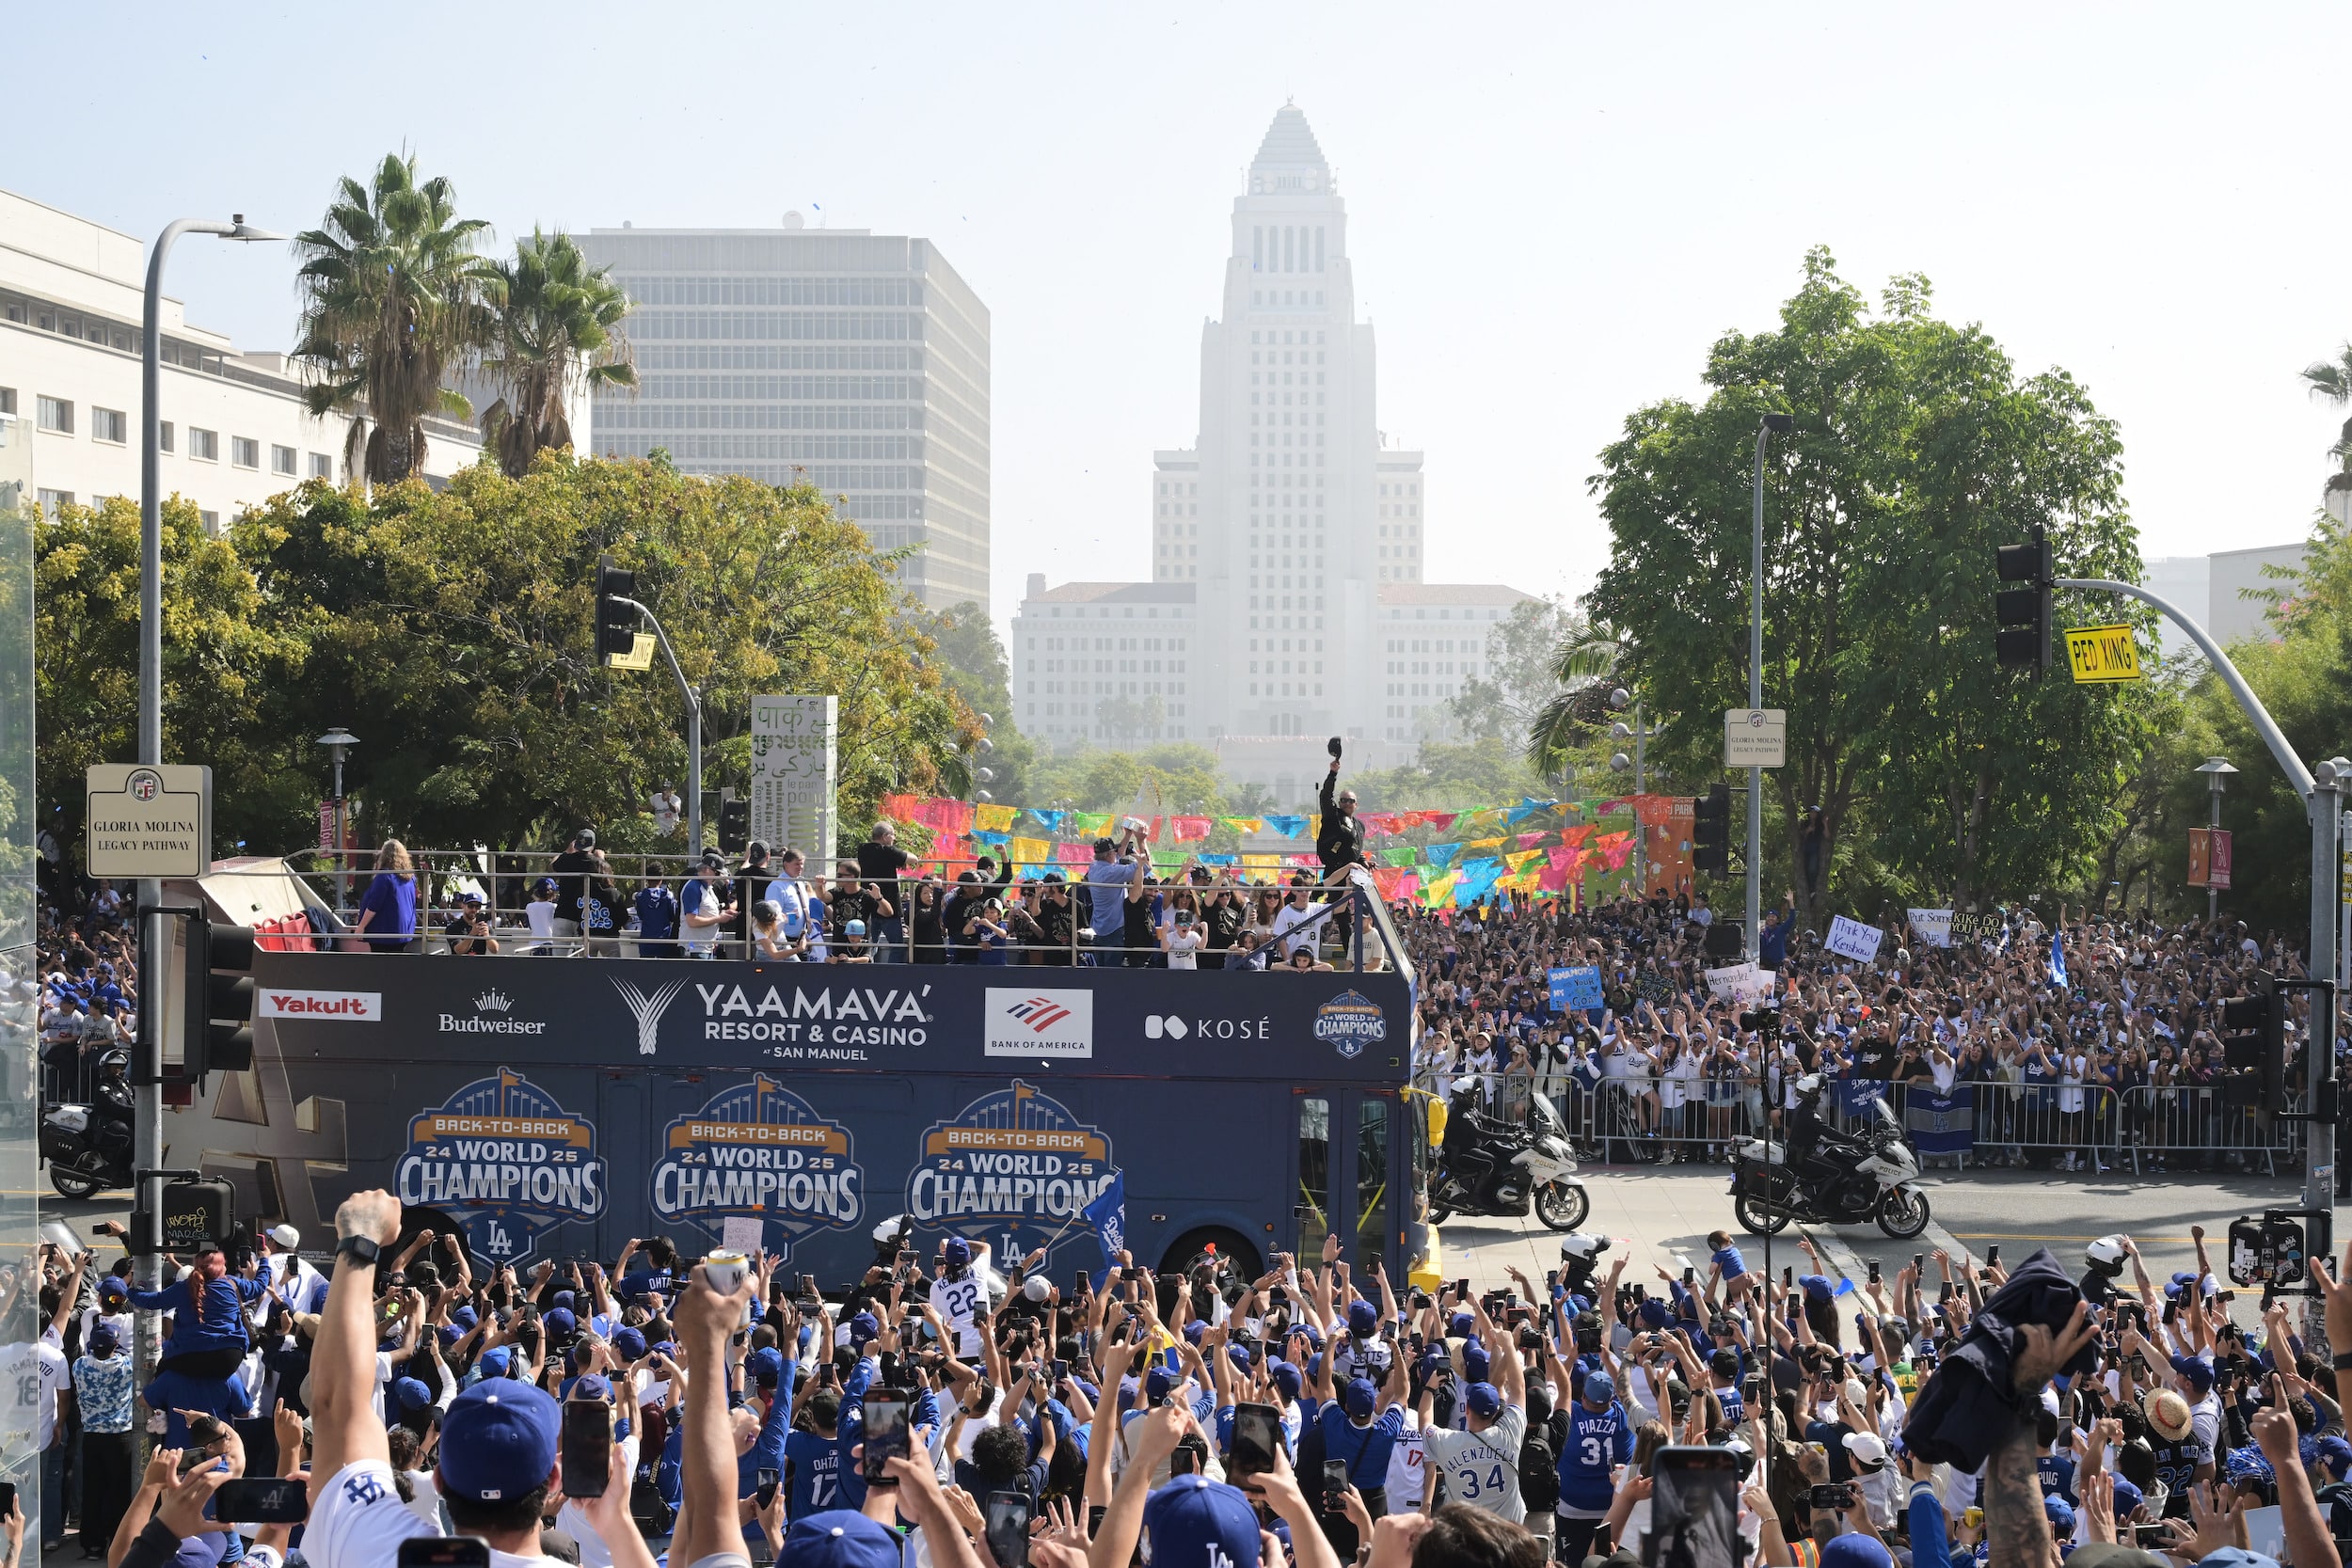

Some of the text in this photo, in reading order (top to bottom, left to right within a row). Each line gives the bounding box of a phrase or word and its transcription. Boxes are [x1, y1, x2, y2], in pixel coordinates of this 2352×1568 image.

[631, 641, 651, 662] XING
[2073, 636, 2131, 672] PED XING
[1675, 804, 1694, 815] PARK
[94, 821, 194, 832] GLORIA MOLINA
[98, 840, 190, 850] LEGACY PATHWAY
[1833, 934, 1870, 957] Kershaw
[1708, 970, 1750, 986] Hernandez
[270, 995, 368, 1015] Yakult
[438, 1013, 546, 1035] Budweiser
[1198, 1016, 1270, 1039] KOSÉ
[1335, 1013, 1366, 1022] WORLD
[706, 1022, 927, 1046] RESORT & CASINO
[1315, 1019, 1384, 1038] CHAMPIONS
[773, 1046, 803, 1058] SAN
[807, 1048, 868, 1061] MANUEL
[991, 1040, 1020, 1049] BANK
[1038, 1041, 1086, 1050] AMERICA
[436, 1118, 568, 1135] BACK-TO-BACK
[1933, 1113, 1949, 1132] LA
[691, 1125, 826, 1142] BACK-TO-BACK
[948, 1132, 1085, 1148] BACK-TO-BACK
[57, 1141, 72, 1151] LAPD
[425, 1140, 578, 1163] 24 WORLD 25
[681, 1147, 834, 1170] 24 WORLD 25
[938, 1152, 1093, 1176] 24 WORLD 25
[1534, 1158, 1558, 1171] POLICE
[1879, 1165, 1902, 1176] POLICE
[400, 1155, 603, 1214] CHAMPIONS
[655, 1162, 858, 1222] CHAMPIONS
[487, 1220, 513, 1256] LA
[1001, 1233, 1026, 1269] LA
[946, 1284, 977, 1318] 22
[1355, 1351, 1383, 1363] BETTS
[17, 1375, 41, 1406] 18
[1578, 1418, 1617, 1435] PIAZZA
[1408, 1449, 1423, 1467] 17
[1445, 1447, 1515, 1474] VALENZUELA
[1581, 1436, 1613, 1466] 31
[1459, 1464, 1505, 1499] 34
[2038, 1471, 2058, 1486] PUIG
[2155, 1464, 2194, 1497] 22
[811, 1474, 837, 1507] 17
